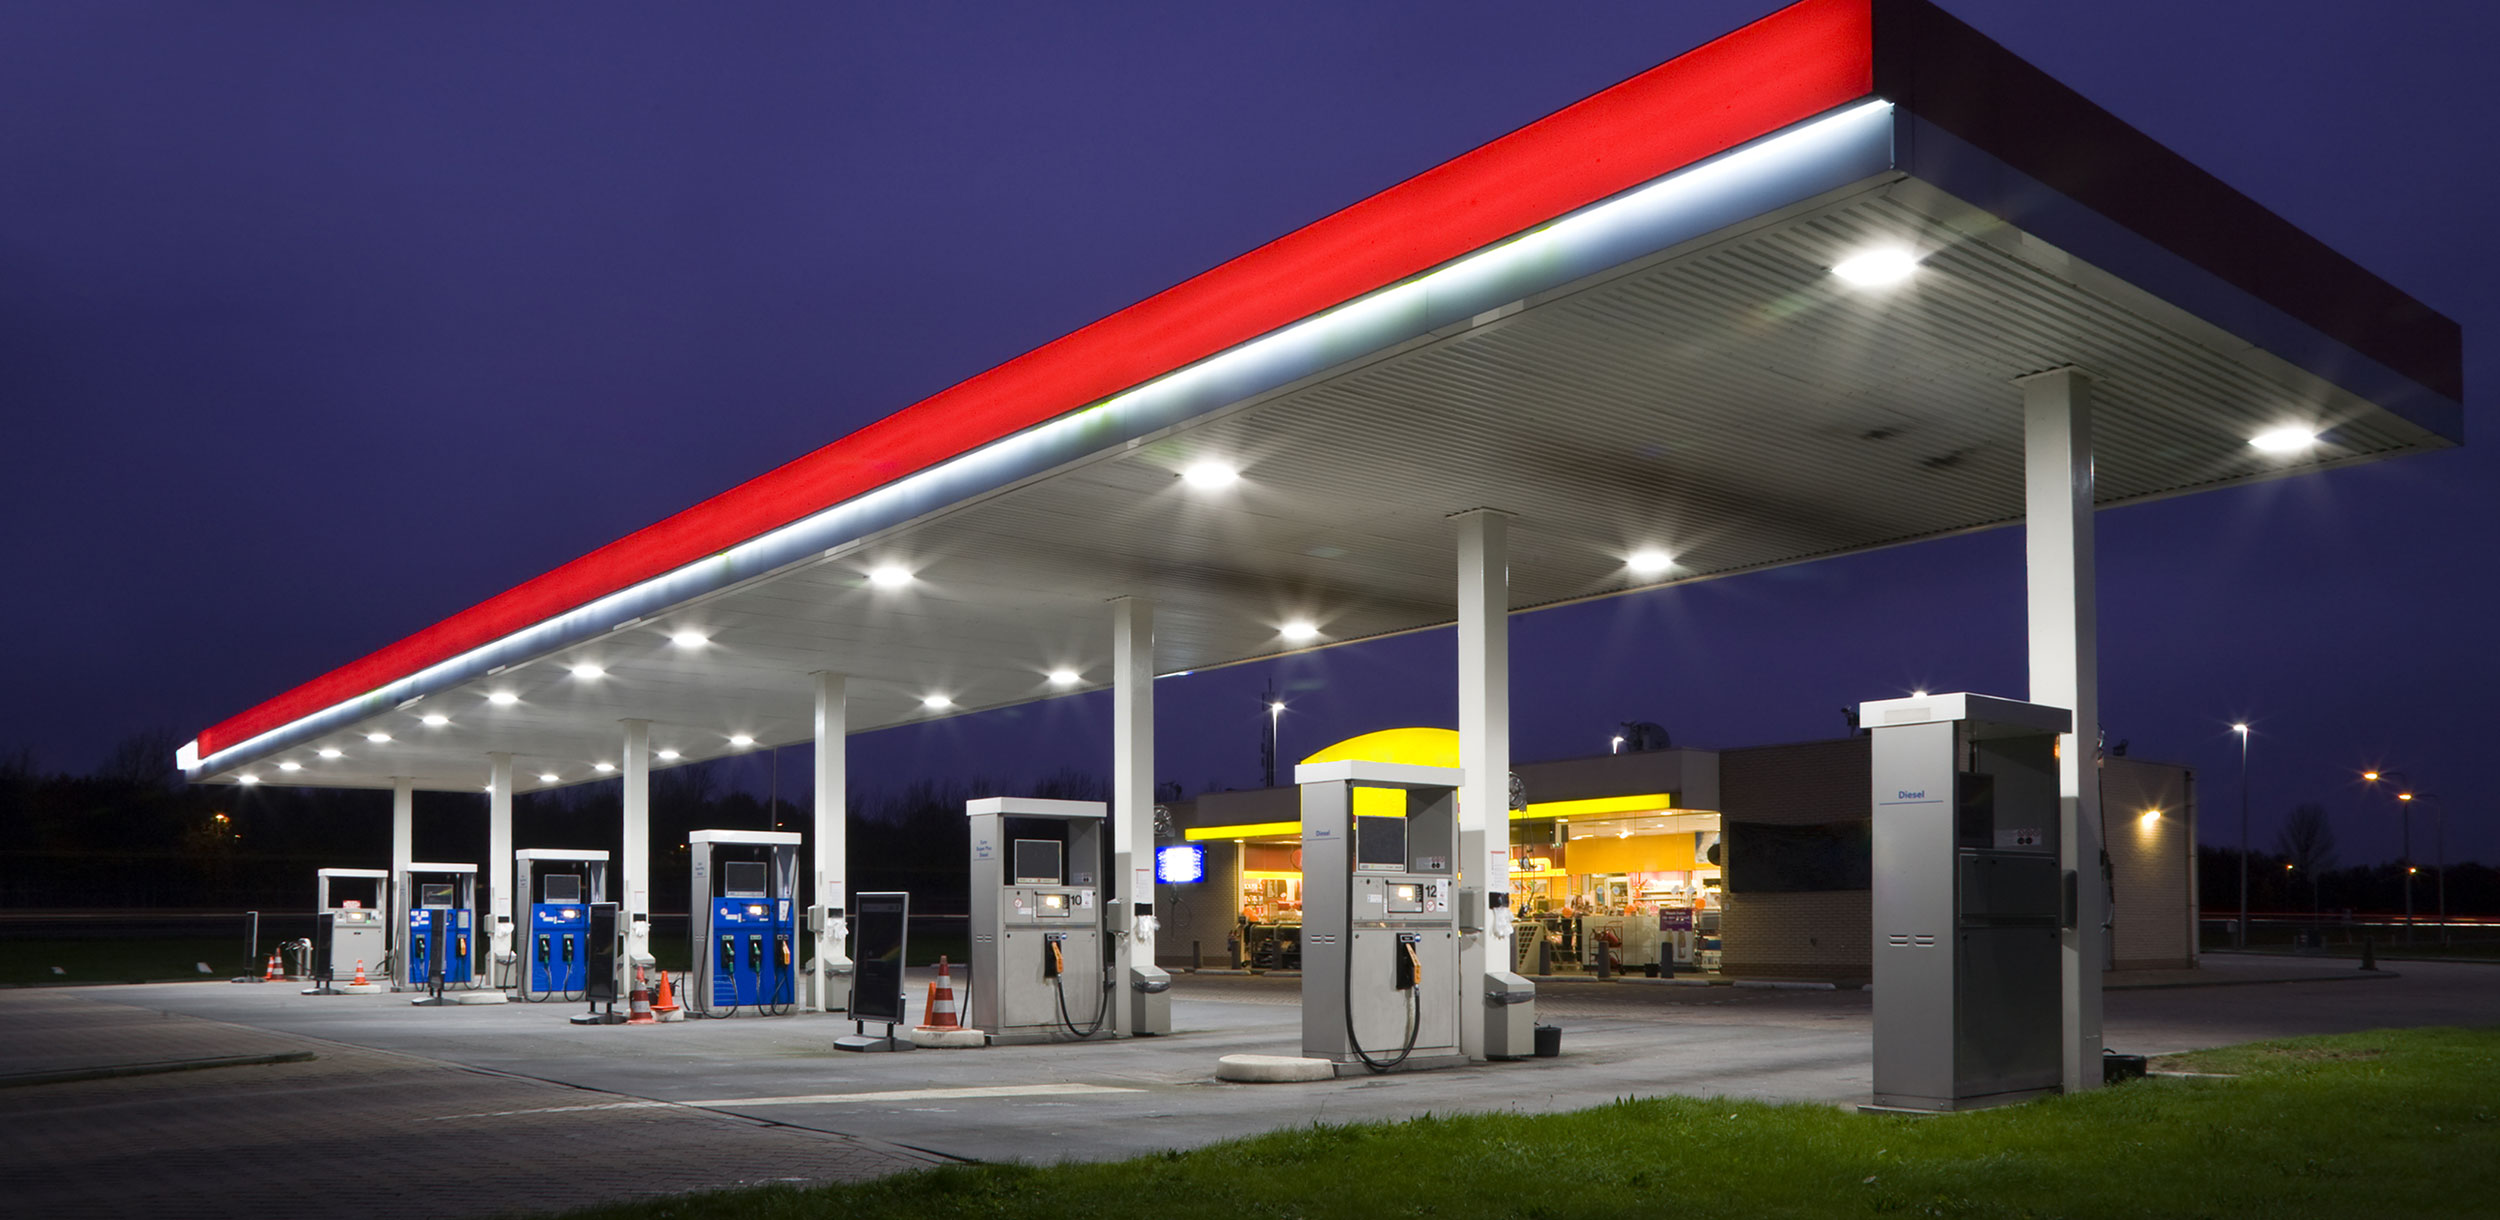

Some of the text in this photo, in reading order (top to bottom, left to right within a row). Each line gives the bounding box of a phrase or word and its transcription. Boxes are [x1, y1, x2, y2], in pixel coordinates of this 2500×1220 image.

[1898, 790, 1925, 799] Diesel
[1425, 885, 1437, 898] 12
[1070, 895, 1082, 906] 10
